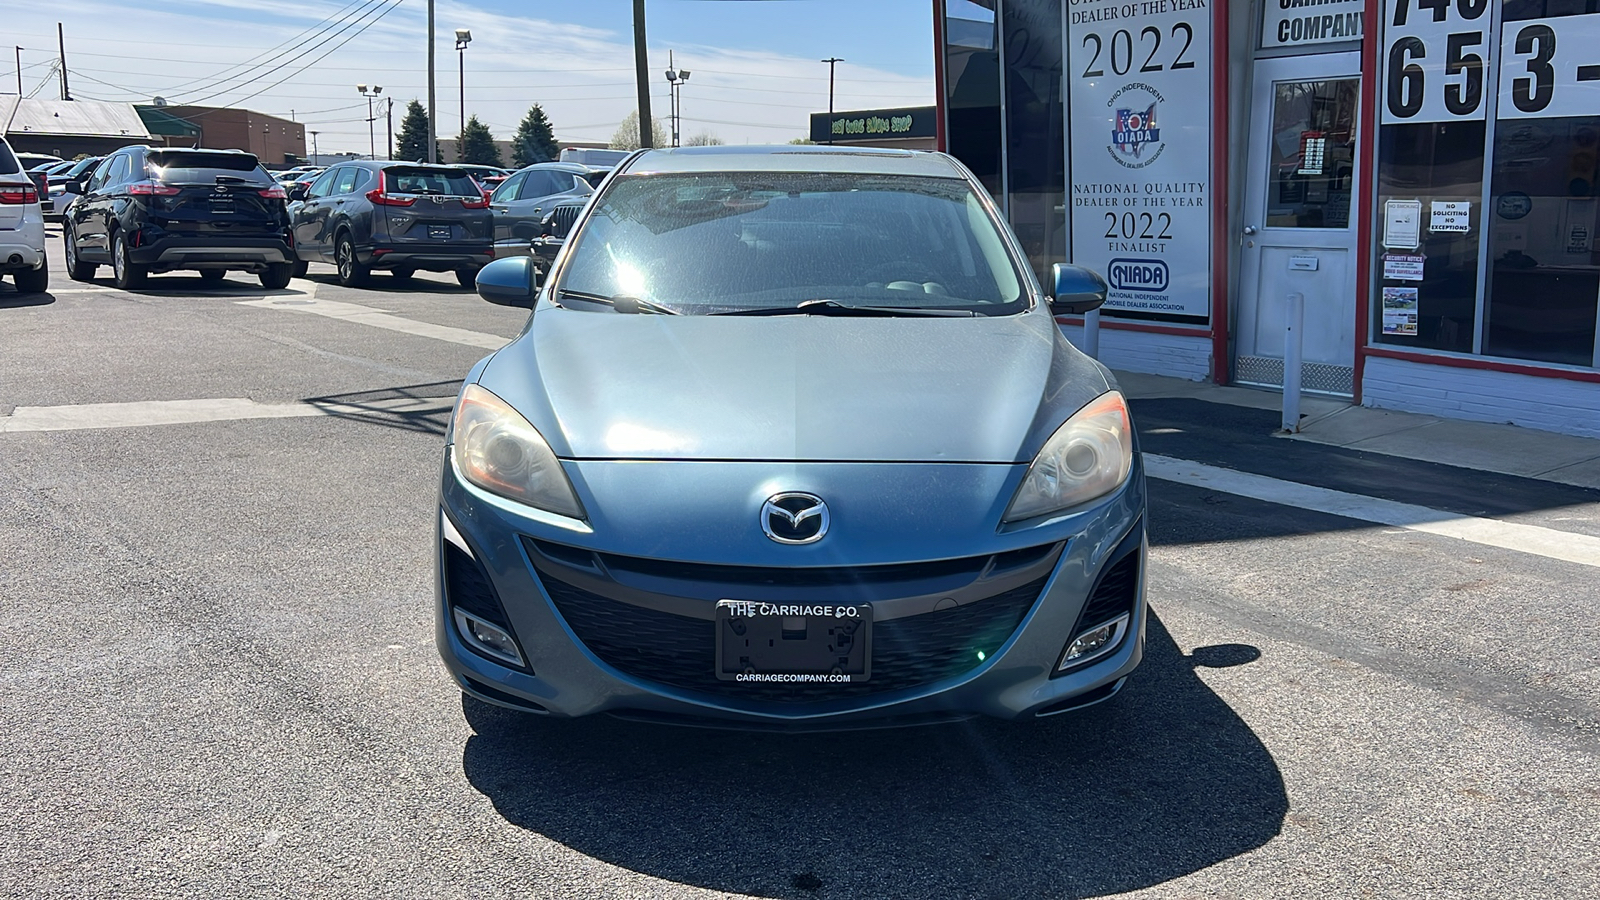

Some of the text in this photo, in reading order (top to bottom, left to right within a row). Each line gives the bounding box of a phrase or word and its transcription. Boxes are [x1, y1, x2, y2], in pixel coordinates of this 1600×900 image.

[1072, 7, 1118, 24] DEALER
[1122, 4, 1138, 18] OF
[1141, 0, 1167, 15] THE
[1170, 0, 1206, 11] YEAR
[1082, 22, 1195, 78] 2022
[1107, 82, 1165, 107] OHIO INDEPENDENT
[1117, 131, 1152, 143] OIADA
[1074, 183, 1206, 195] NATIONAL QUALITY
[1075, 197, 1204, 207] DEALER OF THE YEAR
[1104, 211, 1172, 240] 2022
[1108, 242, 1166, 253] FINALIST
[1112, 265, 1163, 285] NIADA
[1108, 292, 1169, 302] NATIONAL INDEPENDENT
[1127, 301, 1148, 309] DEALERS
[1149, 302, 1185, 311] ASSOCIATION
[729, 604, 860, 618] THE CARRIAGE CO.
[735, 673, 851, 683] CARRIAGECOMPANY.COM
